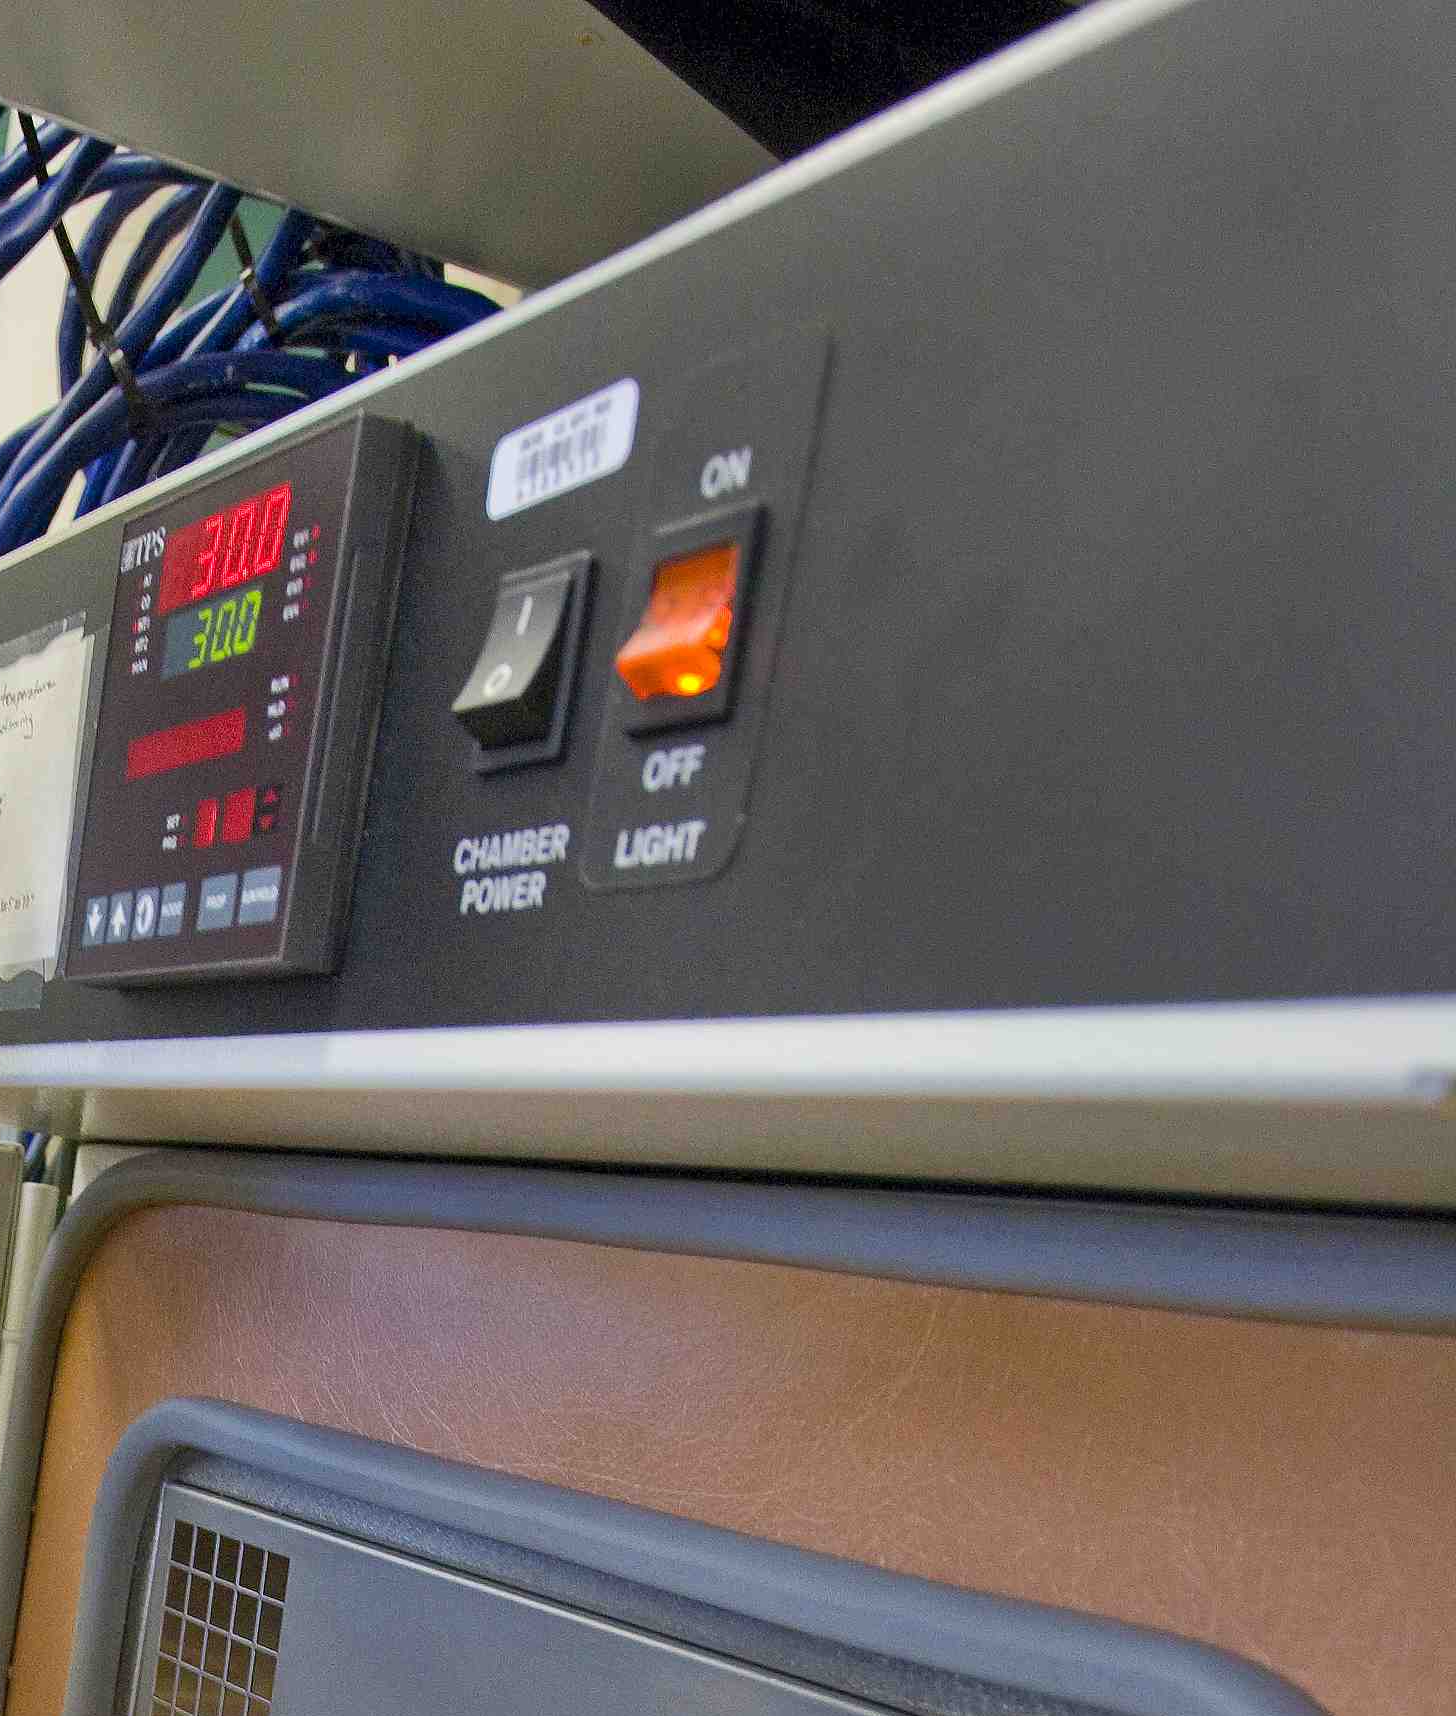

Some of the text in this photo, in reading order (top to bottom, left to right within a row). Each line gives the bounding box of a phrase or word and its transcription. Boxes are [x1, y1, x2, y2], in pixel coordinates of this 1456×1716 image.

[699, 447, 752, 499] ON
[642, 744, 706, 793] OFF
[453, 823, 571, 875] CHAMBER
[614, 820, 707, 869] LIGHT
[460, 871, 547, 916] POWER
